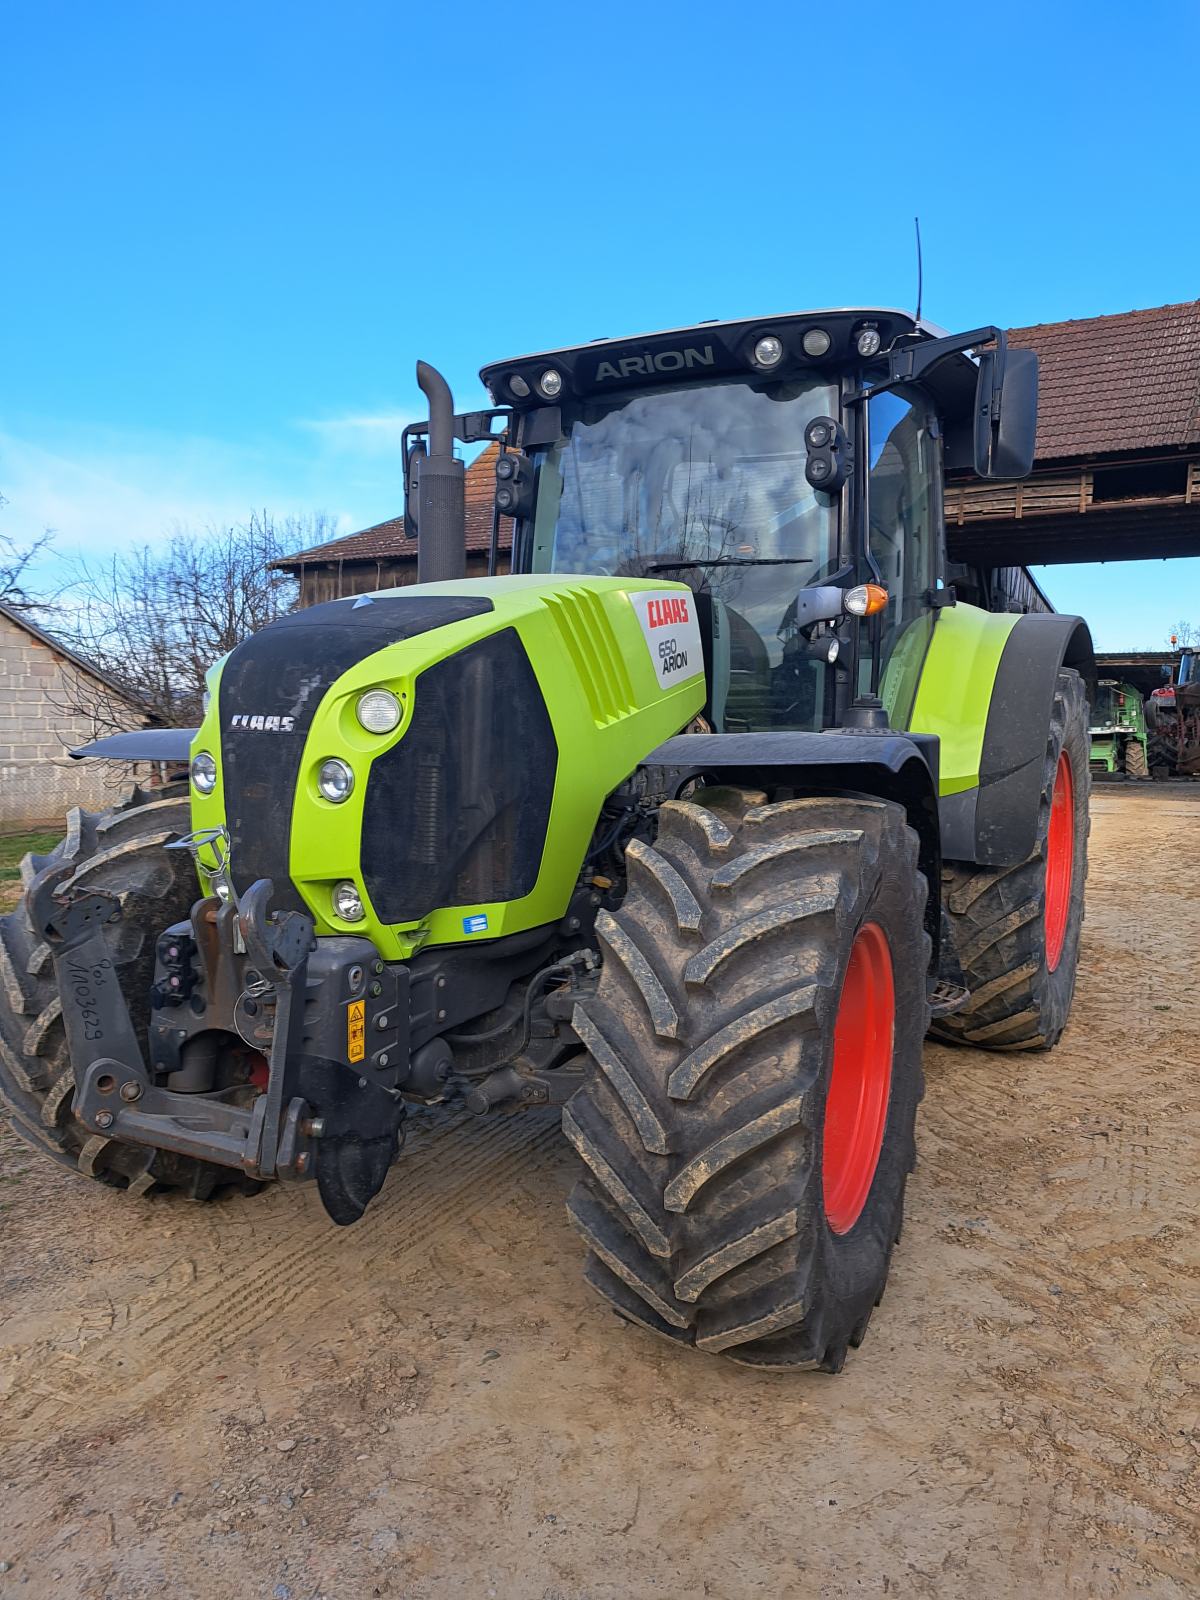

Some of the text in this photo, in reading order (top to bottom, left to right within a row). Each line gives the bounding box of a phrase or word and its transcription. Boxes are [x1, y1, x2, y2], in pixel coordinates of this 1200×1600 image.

[596, 346, 714, 381] ARION
[647, 599, 688, 628] CLAAS
[658, 638, 677, 659] 650
[662, 650, 687, 675] ARION
